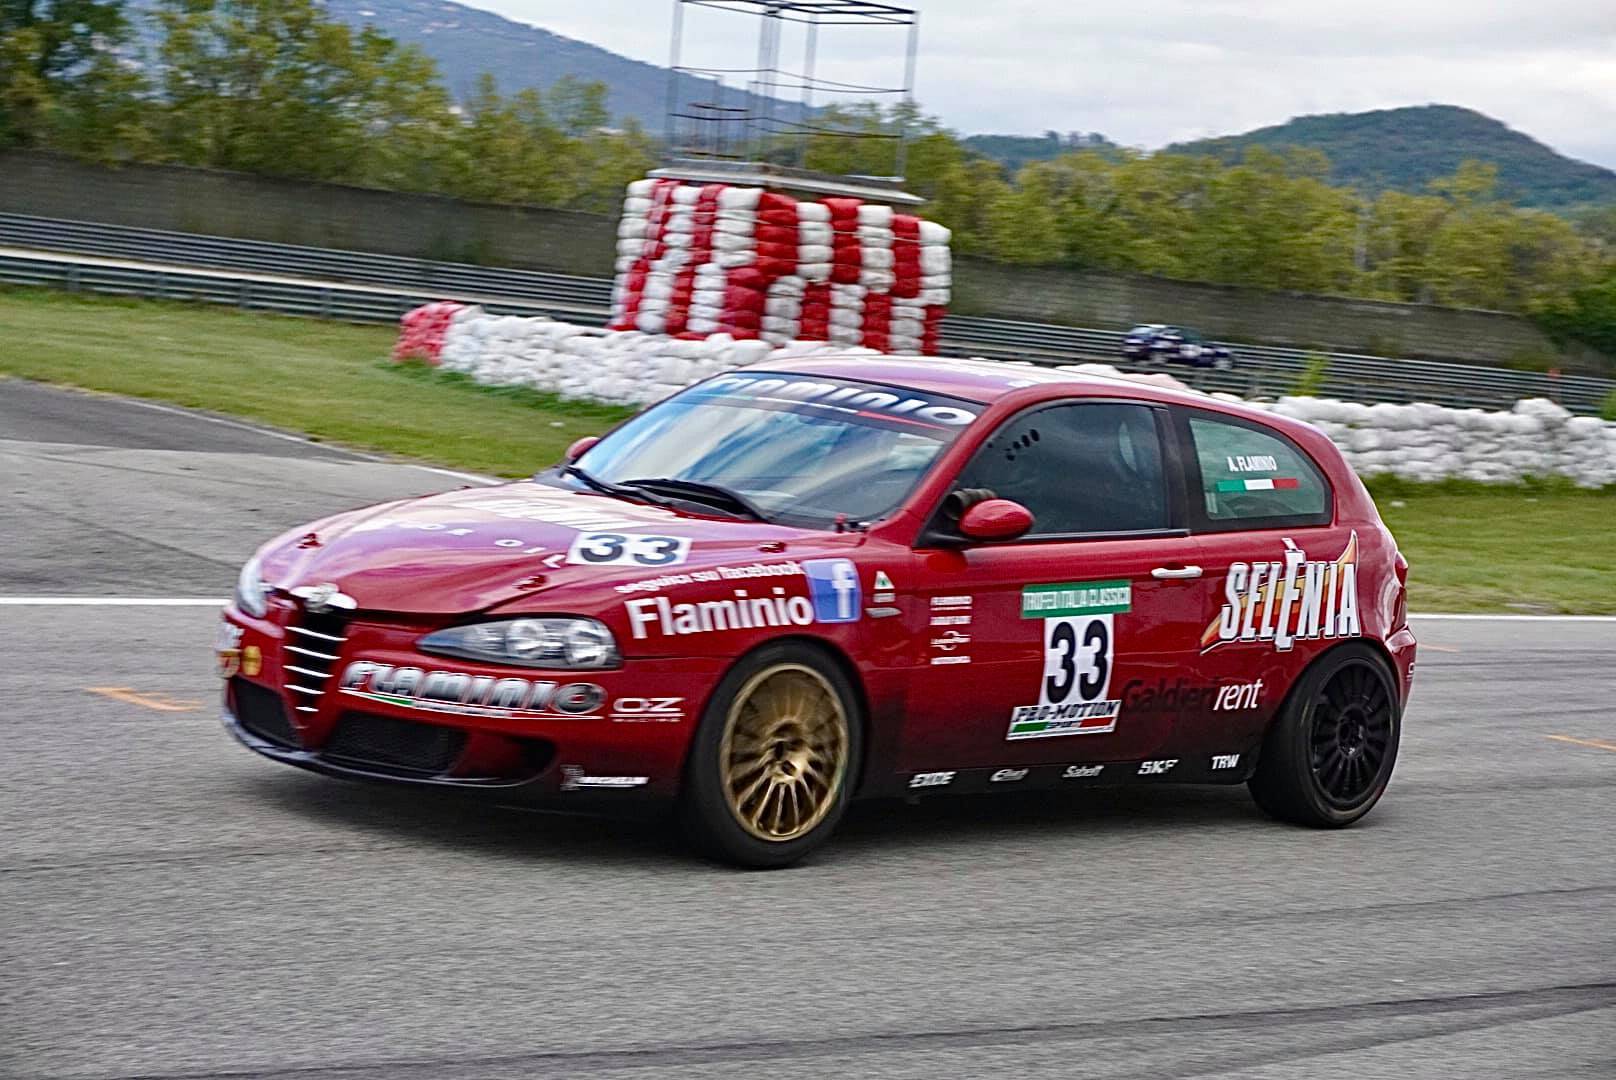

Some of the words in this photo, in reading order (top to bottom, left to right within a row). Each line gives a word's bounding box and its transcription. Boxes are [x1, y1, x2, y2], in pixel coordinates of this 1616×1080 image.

[579, 533, 683, 565] 33
[624, 587, 815, 639] Flaminio
[1046, 619, 1109, 704] 33
[613, 697, 687, 713] OZ
[1212, 678, 1264, 711] rent
[1013, 702, 1119, 722] PRO-MOTION
[1137, 759, 1180, 775] SKF
[1211, 753, 1241, 770] TRW
